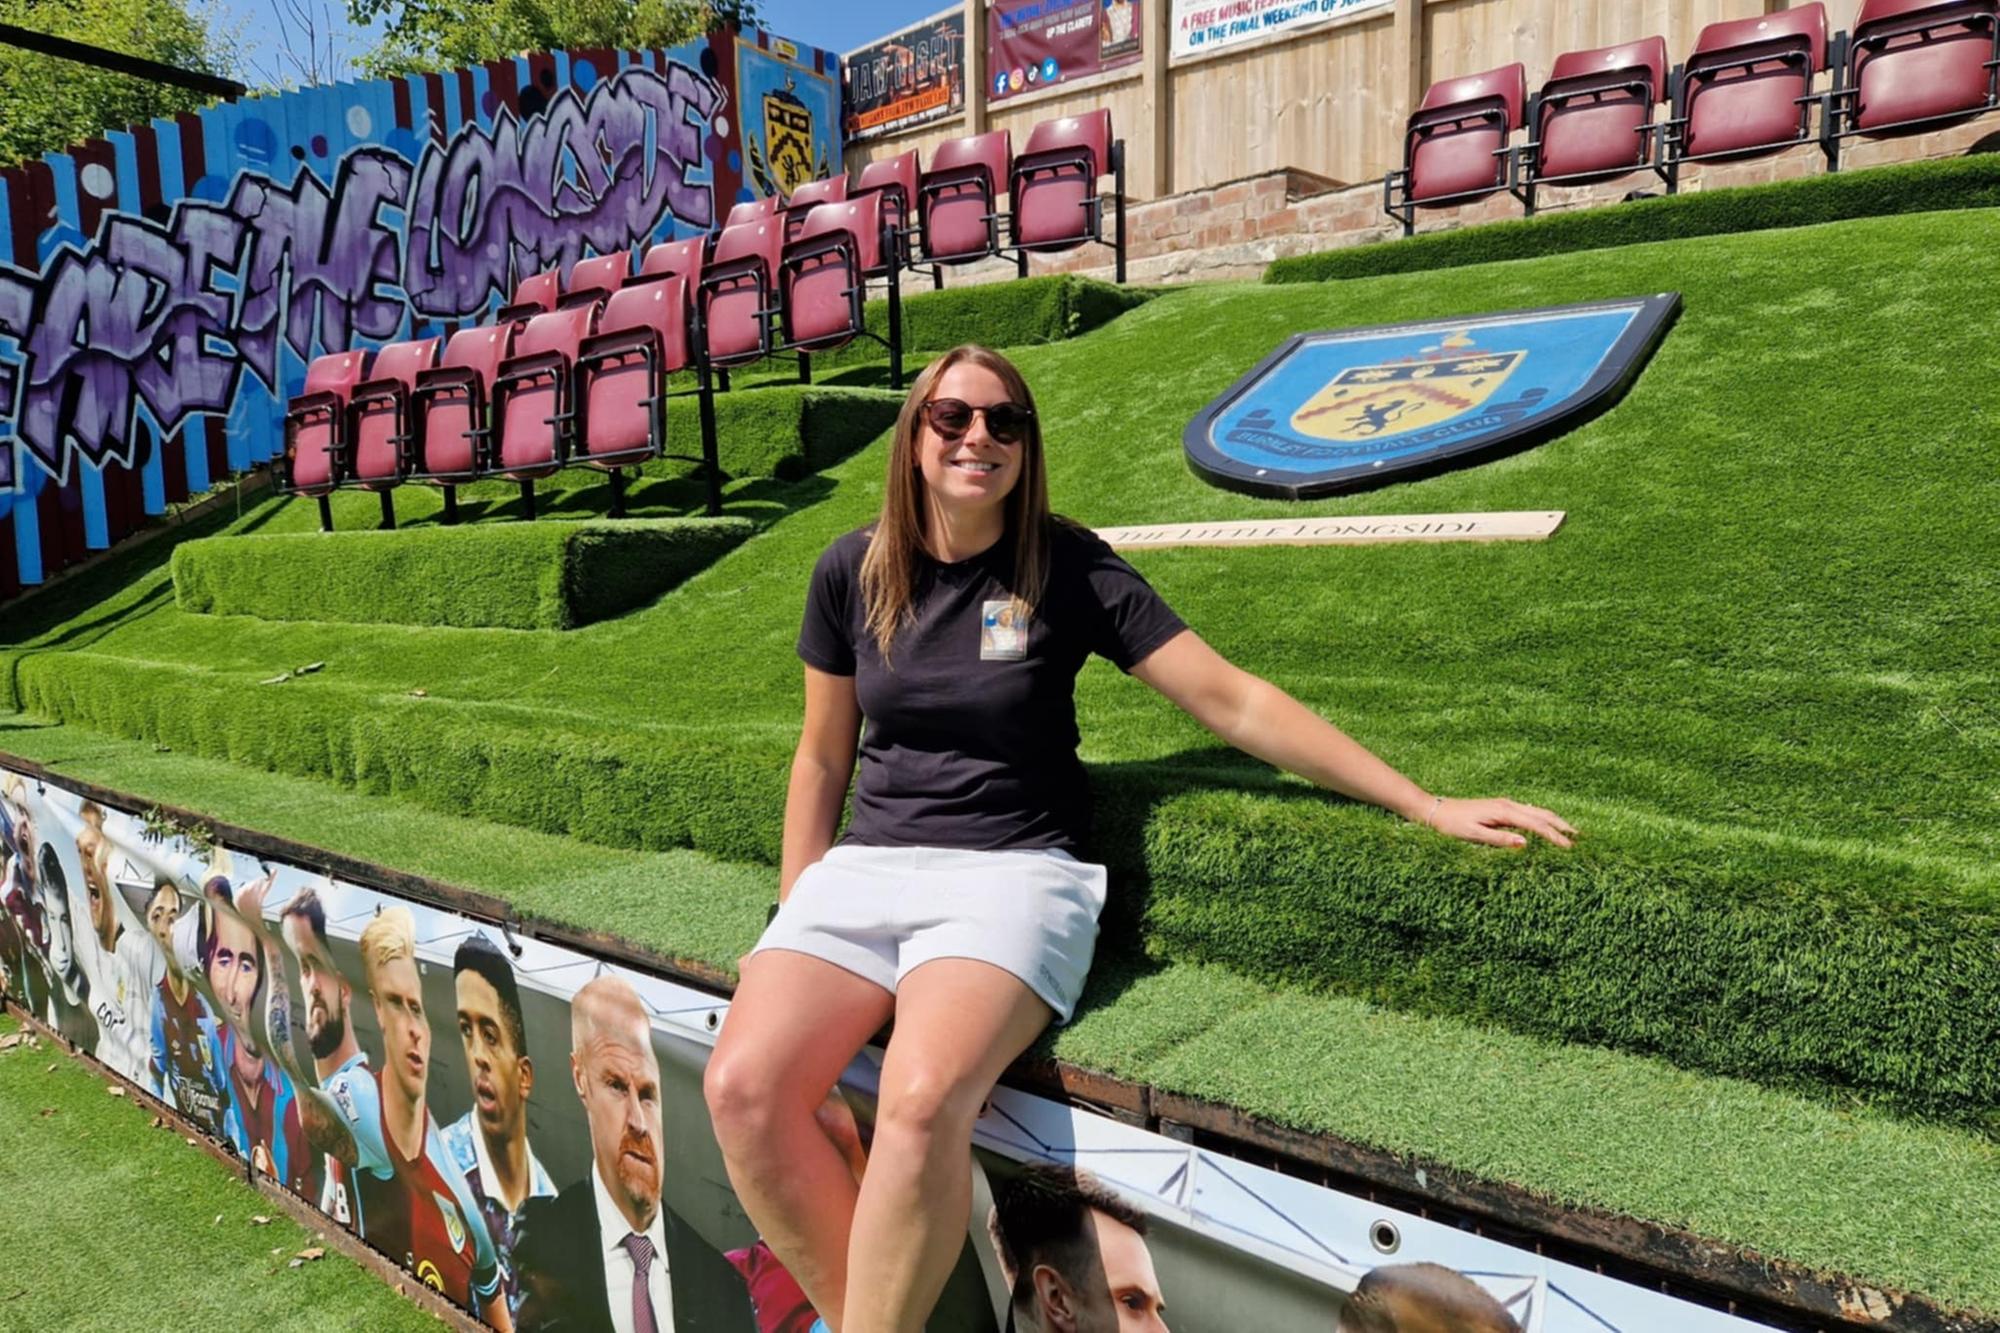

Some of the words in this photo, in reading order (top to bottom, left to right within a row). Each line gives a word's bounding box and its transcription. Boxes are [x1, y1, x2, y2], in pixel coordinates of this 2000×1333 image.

[1055, 22, 1066, 35] THE
[1180, 16, 1189, 31] A
[1191, 8, 1216, 28] FREE
[1218, 0, 1252, 20] MUSIC
[1189, 30, 1204, 46] ON
[1207, 24, 1227, 40] THE
[1229, 15, 1260, 36] FINAL
[1263, 0, 1317, 26] WEEKEND
[1321, 0, 1337, 12] OF
[1302, 435, 1427, 456] FOOTBALL
[1433, 415, 1503, 438] CLUB
[1117, 530, 1168, 542] THE
[1179, 526, 1284, 540] LITTLE
[1293, 521, 1482, 537] LONGSIDE
